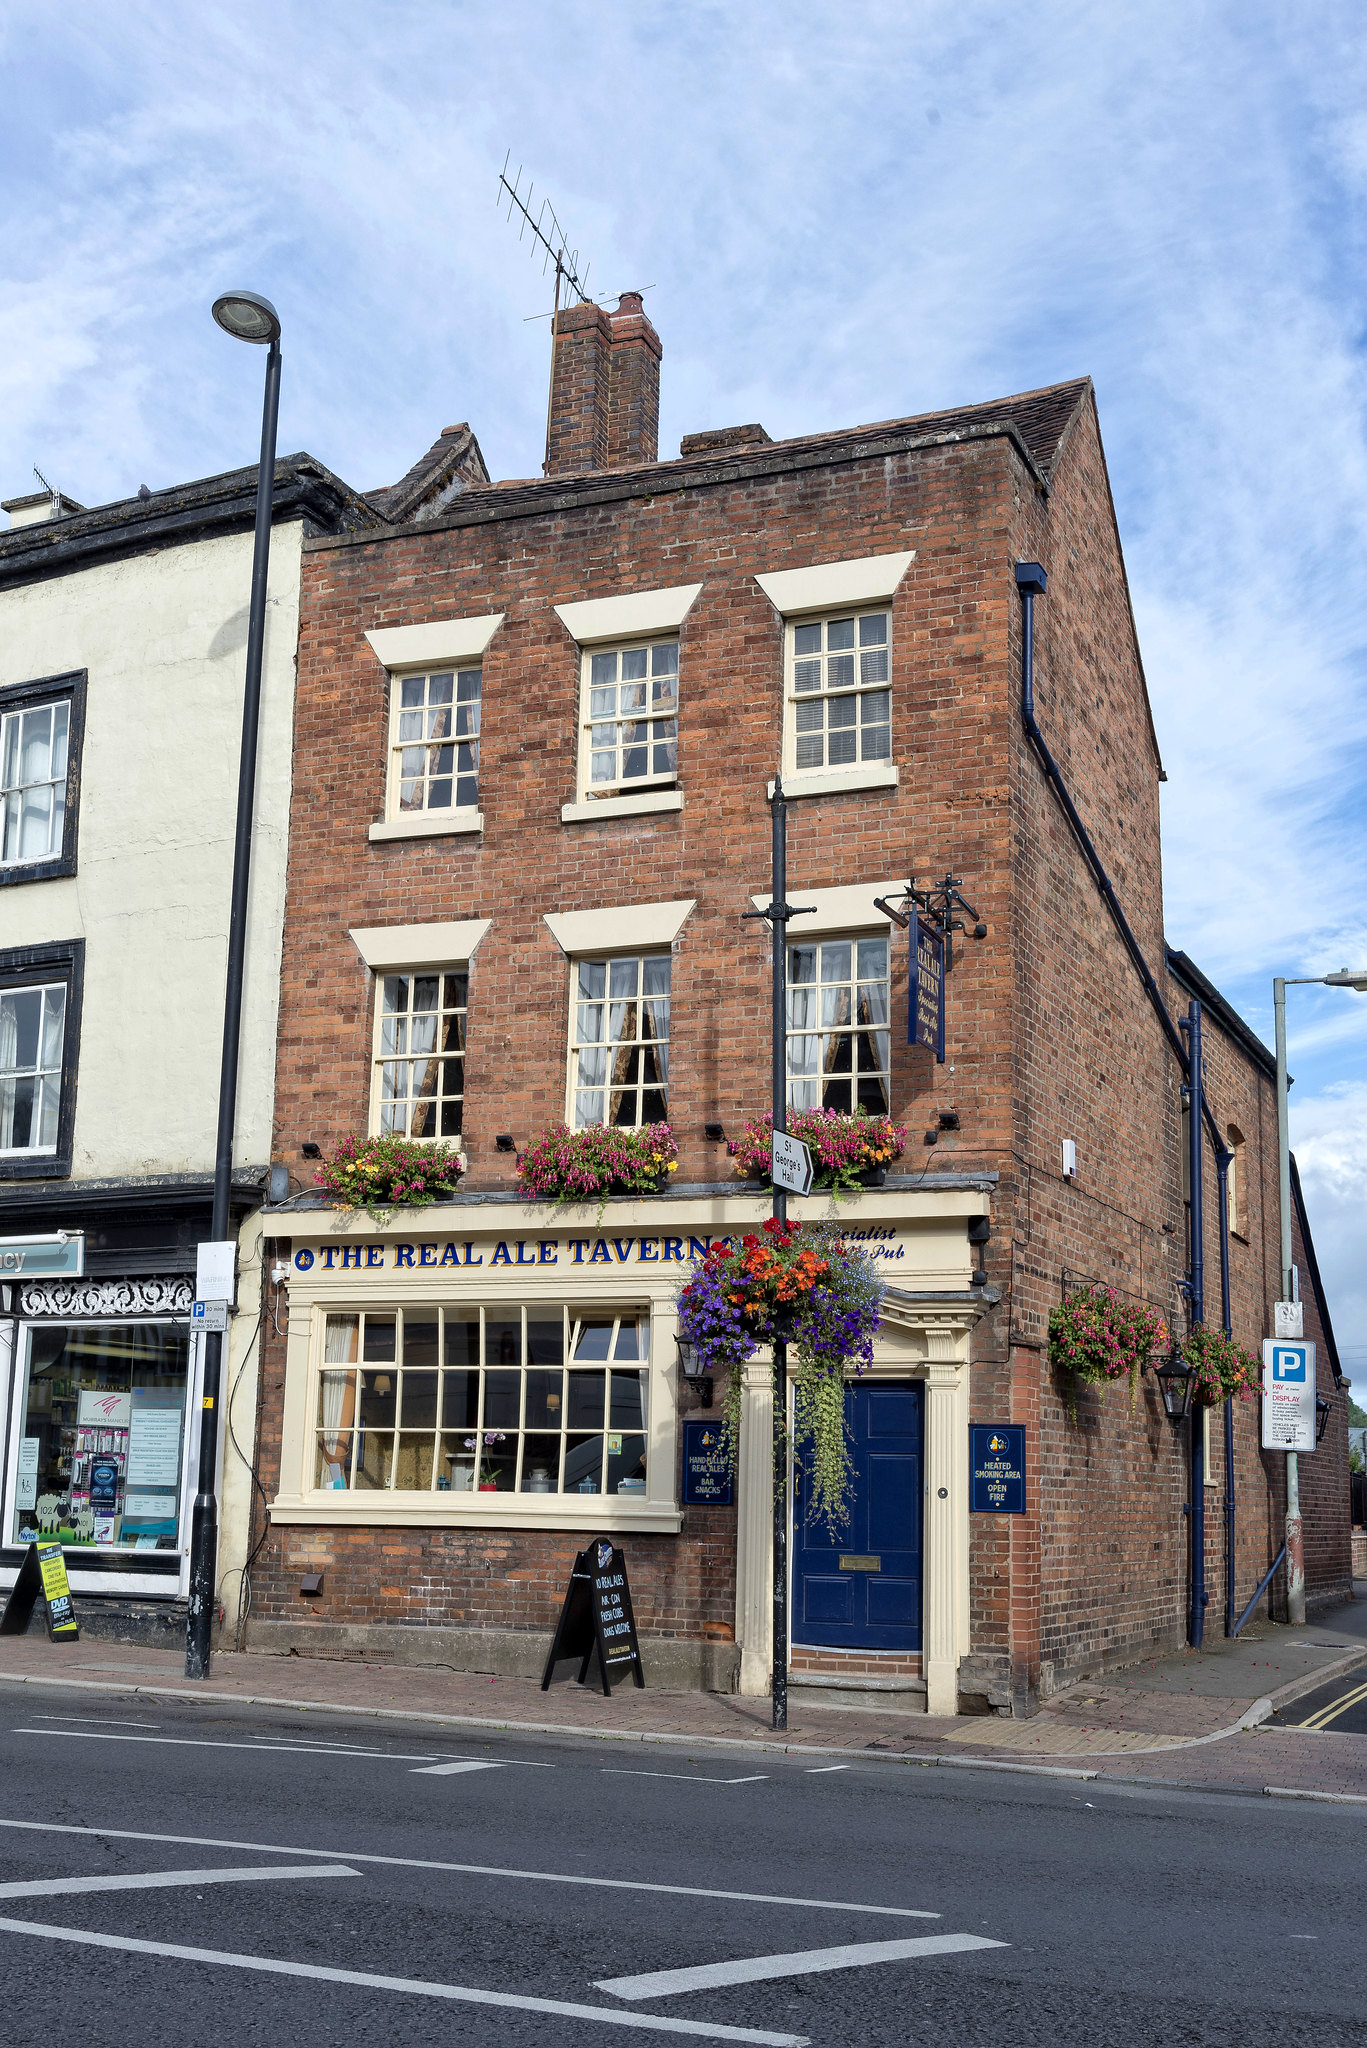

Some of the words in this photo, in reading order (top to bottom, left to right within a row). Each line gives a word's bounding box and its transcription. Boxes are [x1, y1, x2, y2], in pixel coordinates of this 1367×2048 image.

[924, 936, 933, 954] THE
[918, 966, 939, 998] TAVERN
[785, 1140, 791, 1153] St
[775, 1151, 800, 1171] George's
[782, 1169, 794, 1184] Hall
[318, 1244, 384, 1270] THE
[392, 1242, 483, 1270] REAL
[488, 1240, 558, 1267] ALE
[567, 1236, 713, 1266] TAVERN
[870, 1244, 905, 1260] Pub
[0, 1252, 26, 1273] cy
[196, 1304, 204, 1316] P
[1278, 1352, 1301, 1377] P
[692, 1465, 708, 1473] REAL
[709, 1465, 725, 1473] ALES
[984, 1462, 1012, 1470] HEATED
[975, 1470, 1004, 1478] SMOKING
[695, 1486, 721, 1494] SNACKS
[988, 1484, 1007, 1492] OPEN
[989, 1493, 1005, 1501] FIRE
[41, 1506, 53, 1515] 102
[21, 1532, 36, 1541] Nytol
[40, 1551, 61, 1561] TRANSFER
[601, 1576, 614, 1588] REAL
[613, 1575, 624, 1586] ALES
[50, 1596, 68, 1610] DVD
[54, 1610, 71, 1619] Blu-ray
[601, 1610, 614, 1622] FRESH
[603, 1626, 615, 1638] DOGS
[614, 1621, 631, 1635] WELCOME
